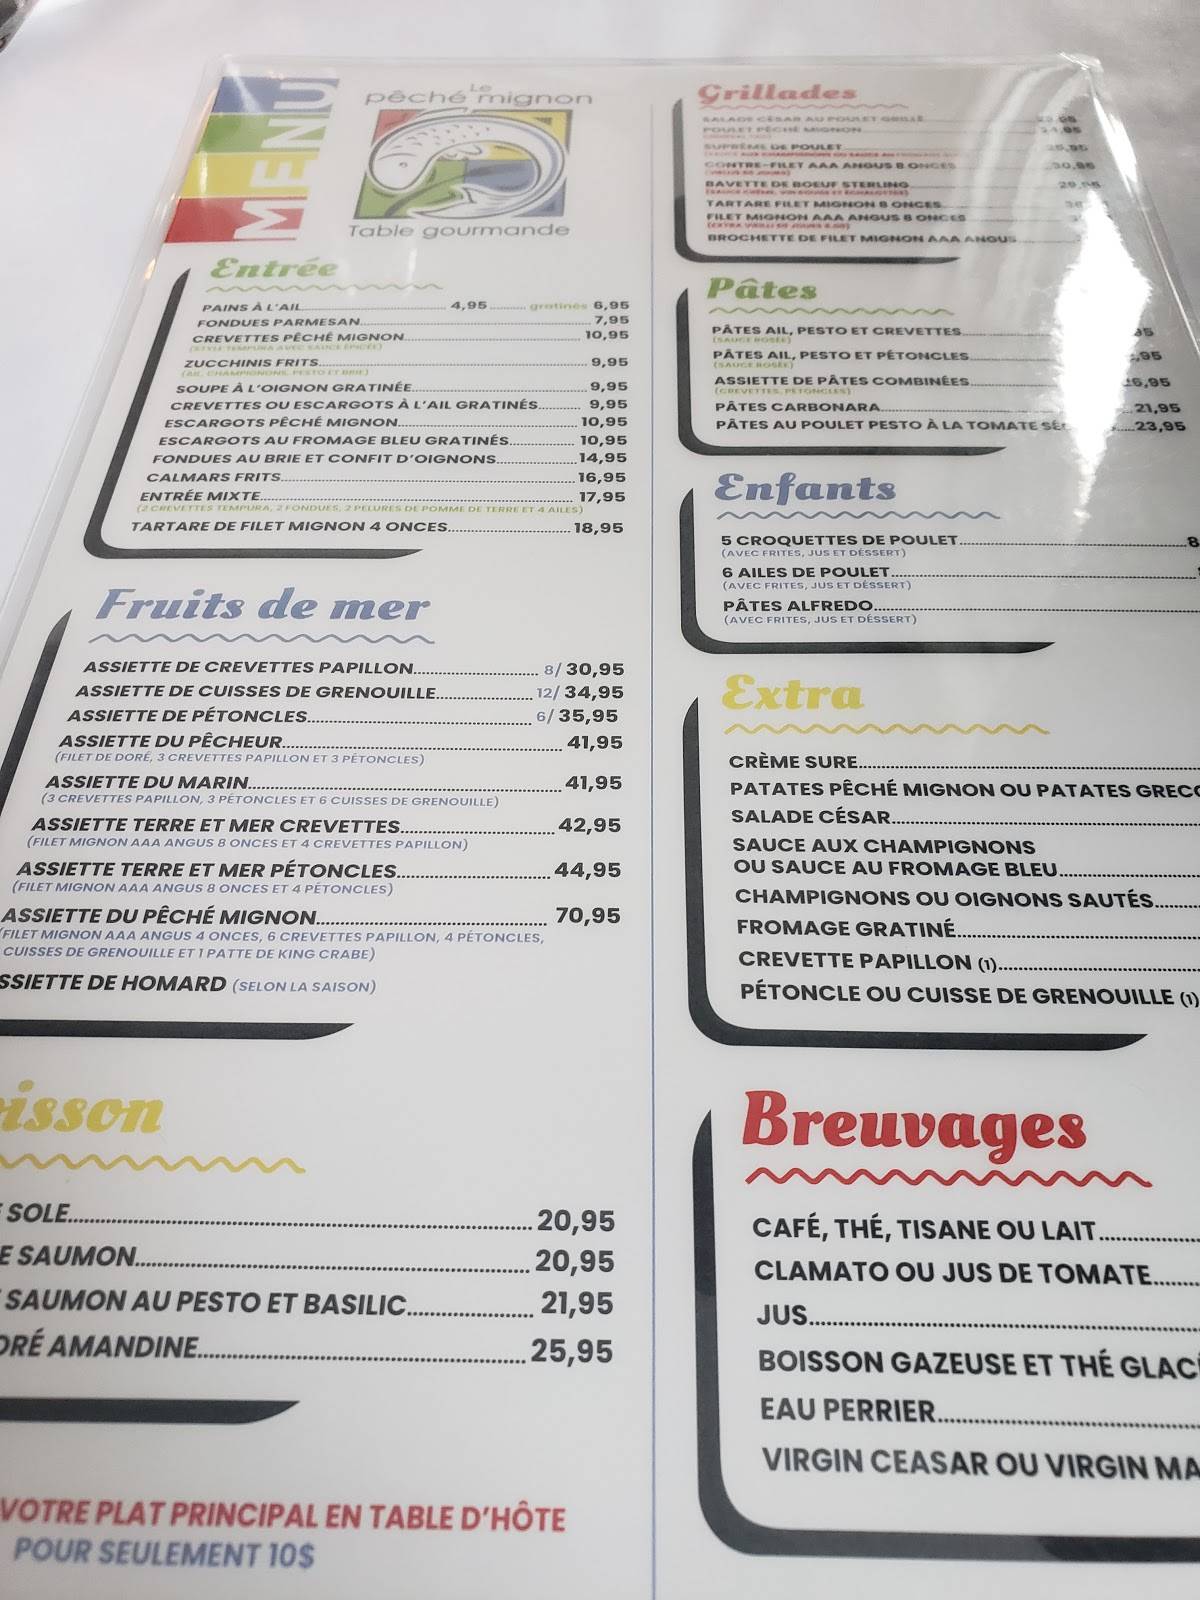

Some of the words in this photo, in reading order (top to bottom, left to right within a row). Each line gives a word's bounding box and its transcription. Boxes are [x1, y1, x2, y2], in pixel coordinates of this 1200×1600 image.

[365, 90, 467, 105] pêché
[478, 90, 592, 107] mignon
[698, 83, 857, 104] Grillades
[233, 81, 338, 240] MENU
[349, 224, 414, 237] Table
[422, 224, 570, 240] gourmande
[210, 258, 336, 278] Entrée
[707, 278, 816, 300] Pâtes
[202, 304, 248, 312] PAINS
[252, 302, 262, 311] À
[451, 301, 487, 310] 4,95
[594, 301, 629, 310] 6,95
[198, 320, 269, 328] FONDUES
[274, 318, 360, 326] PARMESAN
[595, 316, 629, 326] 7,95
[712, 324, 761, 335] PÂTES
[765, 326, 793, 336] AIL,
[797, 326, 847, 336] PESTO
[851, 327, 868, 336] ET
[873, 327, 962, 336] CREVETTES
[184, 359, 271, 368] ZUCCHINIS
[592, 358, 628, 368] 9,95
[176, 385, 228, 393] SOUPE
[232, 382, 243, 393] À
[248, 384, 328, 392] L'OIGNON
[332, 381, 412, 392] GRATINÉE
[591, 382, 628, 392] 9,95
[716, 401, 767, 412] PÂTES
[772, 403, 880, 412] CARBONARA
[1134, 403, 1182, 416] 21,95
[165, 419, 265, 428] ESCARGOTS
[269, 416, 322, 427] PÊCHÉ
[326, 418, 399, 427] MIGNON
[582, 417, 627, 428] 10,95
[1134, 421, 1186, 432] 23,95
[147, 473, 230, 482] CALMARS
[235, 473, 280, 482] FRITS
[579, 472, 626, 484] 16,95
[140, 489, 203, 501] ENTRÉE
[207, 492, 260, 501] MIXTE
[580, 492, 625, 504] 17,95
[715, 472, 896, 506] Enfants
[132, 522, 210, 531] TARTARE
[214, 522, 236, 531] DE
[240, 522, 285, 531] FILET
[288, 522, 365, 531] MIGNON
[370, 522, 381, 531] 4
[386, 522, 448, 532] ONCES
[574, 523, 623, 535] 18,95
[722, 536, 731, 545] 5
[736, 536, 857, 547] CROQUETTES
[862, 536, 885, 545] DE
[890, 536, 958, 545] POULET
[722, 549, 758, 558] (AVEC
[763, 546, 804, 557] FRITES,
[849, 548, 906, 558] DÉSSERT)
[96, 589, 245, 619] Fruits
[258, 587, 318, 619] de
[330, 600, 430, 620] mer
[724, 598, 782, 611] PÂTES
[788, 600, 872, 611] ALFREDO
[83, 662, 172, 672] ASSIETTE
[176, 662, 200, 672] DE
[205, 662, 314, 673] CREVETTES
[319, 662, 415, 674] PAPILLON
[566, 663, 624, 678] 30,95
[722, 674, 864, 710] Extra
[67, 710, 158, 722] ASSIETTE
[162, 710, 188, 722] DE
[192, 706, 308, 722] PÉTONCLES
[559, 709, 618, 725] 35,95
[59, 735, 151, 747] ASSIETTE
[155, 736, 184, 747] DU
[188, 732, 284, 748] PÊCHEUR
[568, 736, 622, 752] 41,95
[55, 751, 93, 763] (FILET
[95, 753, 112, 761] DE
[115, 751, 152, 763] DORÉ,
[157, 753, 165, 761] 3
[168, 754, 242, 762] CREVETTES
[245, 754, 309, 762] PAPILLON
[332, 755, 338, 763] 3
[342, 753, 424, 766] PÉTONCLES)
[729, 752, 800, 768] CRÈME
[805, 756, 858, 768] SURE
[732, 810, 813, 823] SALADE
[819, 806, 890, 824] CÉSAR
[31, 818, 128, 831] ASSIETTE
[134, 818, 196, 832] TERRE
[200, 819, 225, 832] ET
[229, 819, 274, 832] MER
[280, 820, 402, 833] CREVETTES
[559, 818, 620, 835] 42,95
[733, 838, 805, 852] SAUCE
[812, 839, 858, 852] AUX
[864, 839, 1035, 854] CHAMPIGNONS
[734, 860, 765, 873] OU
[772, 860, 846, 874] SAUCE
[852, 861, 882, 875] AU
[888, 861, 1000, 877] FROMAGE
[1005, 863, 1058, 877] BLEU
[1, 907, 102, 924] ASSIETTE
[106, 909, 138, 923] DU
[142, 905, 215, 924] PÊCHÉ
[220, 910, 317, 925] MIGNON
[556, 908, 620, 926] 70,95
[739, 951, 855, 968] CREVETTE
[859, 952, 972, 970] PAPILLON
[0, 974, 84, 990] SSIETTE
[88, 975, 118, 990] DE
[122, 975, 226, 991] HOMARD
[233, 979, 286, 994] (SELON
[290, 982, 307, 992] LA
[312, 980, 376, 995] SAISON)
[743, 1090, 1086, 1165] Breuvages
[7, 1203, 70, 1223] SOLE
[538, 1209, 614, 1236] 20,95
[753, 1212, 828, 1242] CAFÉ,
[834, 1213, 891, 1242] THÉ,
[897, 1220, 990, 1239] TISANE
[997, 1220, 1034, 1240] OU
[1042, 1221, 1095, 1240] LAIT
[18, 1246, 136, 1266] SAUMON
[536, 1249, 614, 1276] 20,95
[757, 1304, 807, 1325] JUS
[47, 1335, 199, 1358] AMANDINE
[531, 1338, 612, 1367] 25,95
[761, 1398, 815, 1420] EAU
[824, 1398, 935, 1422] PERRIER
[0, 1497, 91, 1525] VOTRE
[96, 1500, 166, 1526] PLAT
[170, 1502, 318, 1529] PRINCIPAL
[325, 1504, 362, 1529] EN
[370, 1505, 454, 1530] TABLE
[461, 1500, 566, 1532] D'HÔTE
[14, 1537, 93, 1563] POUR
[98, 1540, 262, 1568] SEULEMENT
